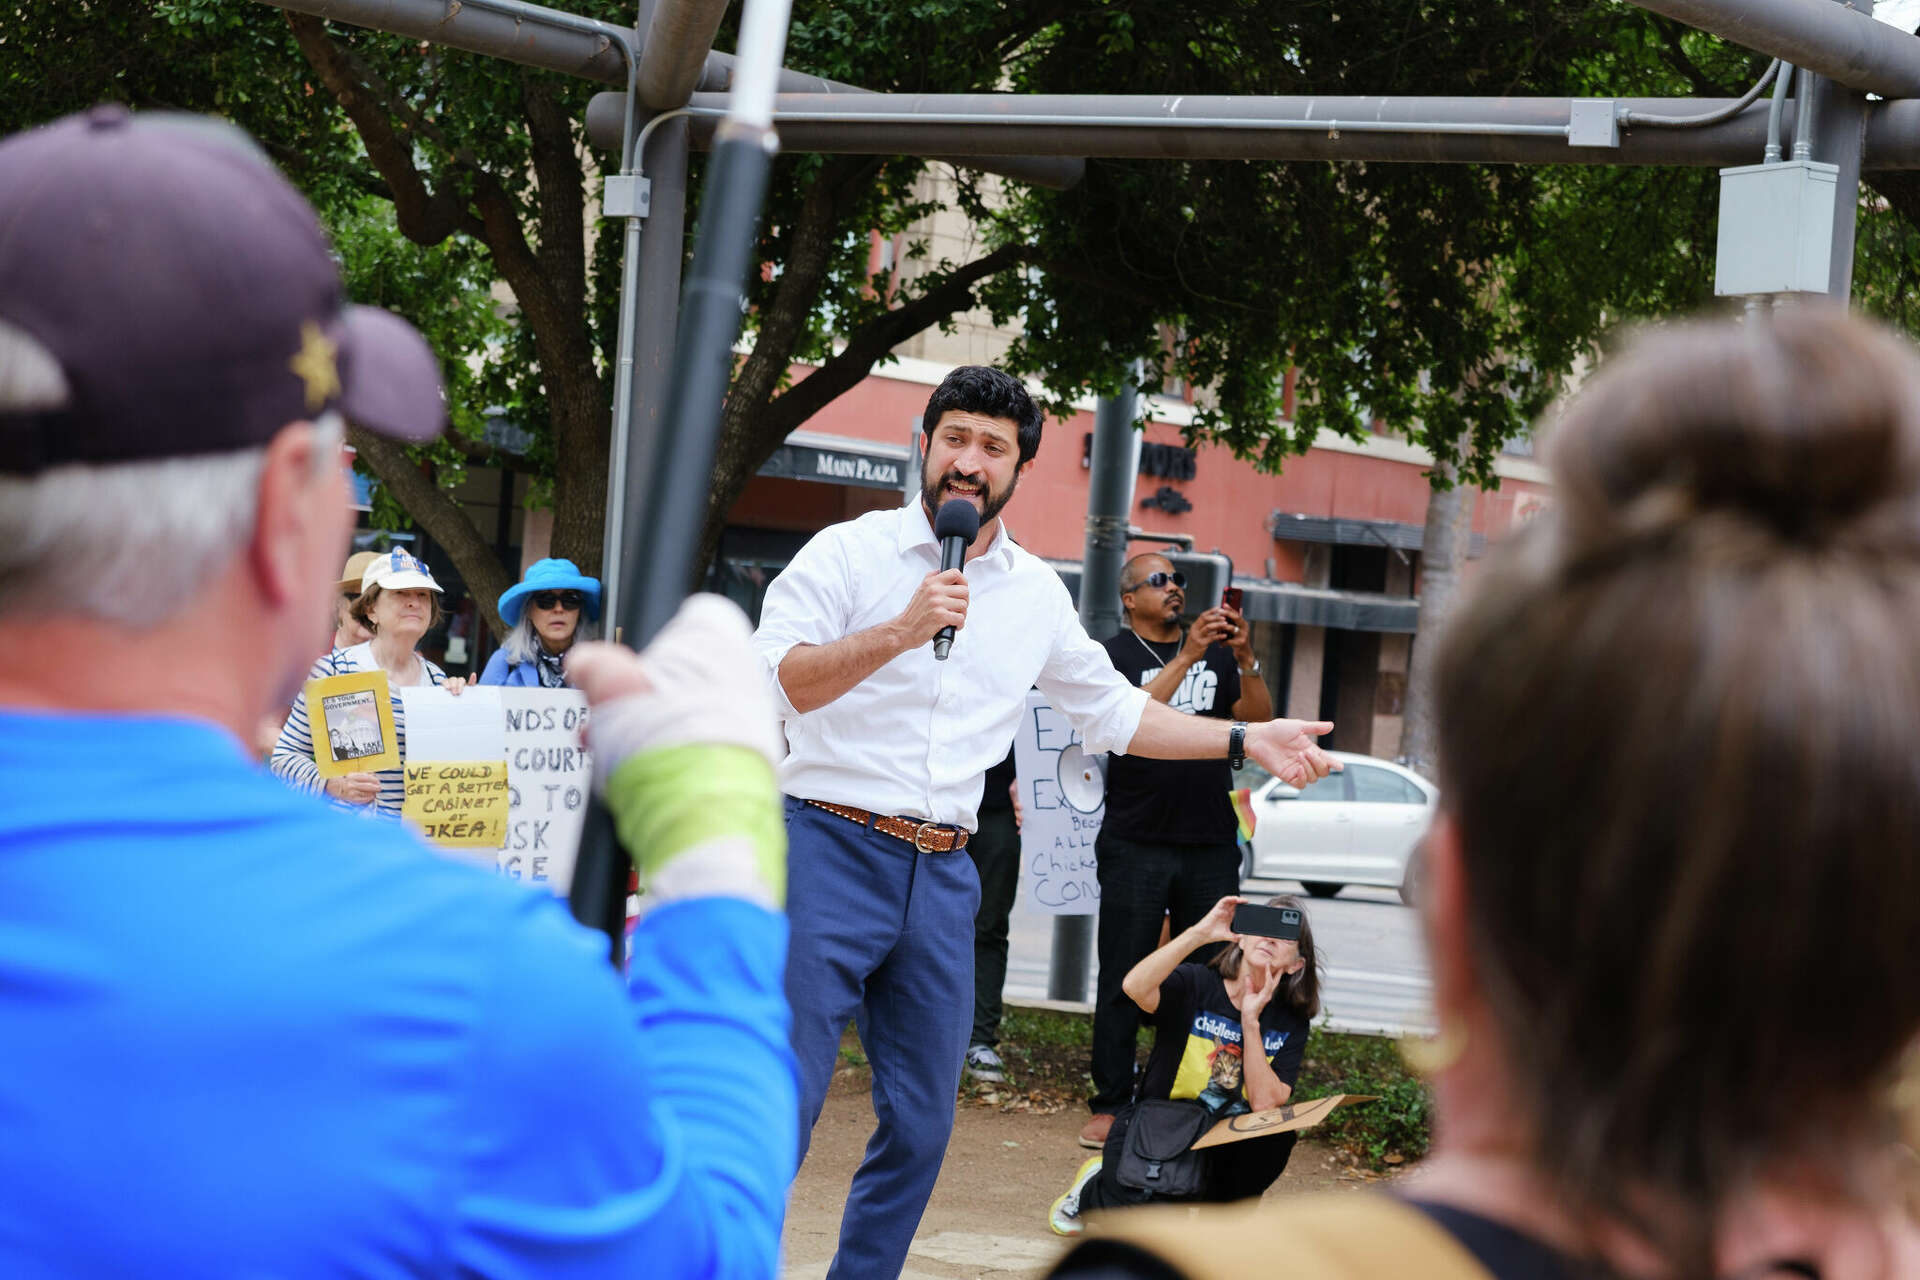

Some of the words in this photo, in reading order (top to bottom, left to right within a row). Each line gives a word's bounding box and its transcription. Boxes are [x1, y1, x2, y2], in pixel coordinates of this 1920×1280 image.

[408, 767, 431, 780] WE
[438, 766, 491, 779] COULD
[407, 783, 435, 795] GET
[440, 783, 451, 794] A
[542, 784, 582, 812] TO
[1055, 836, 1091, 849] ALL
[1195, 1016, 1241, 1042] Childless
